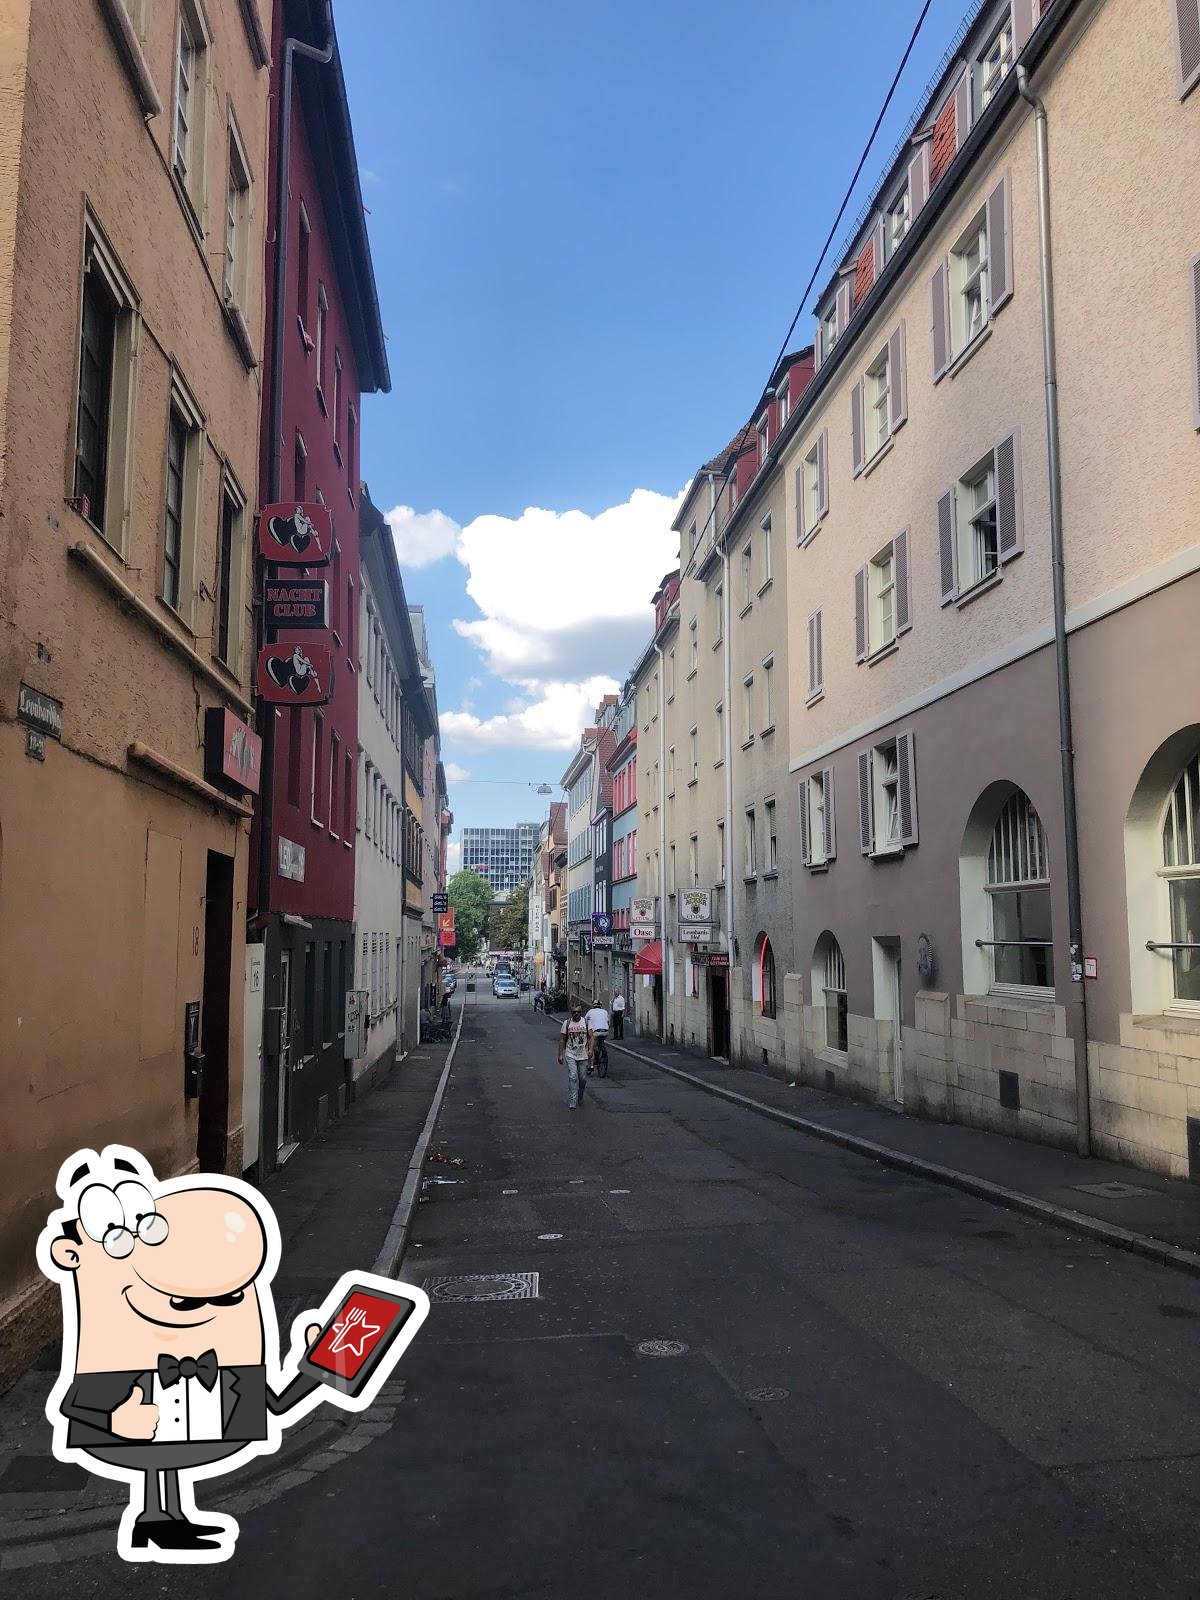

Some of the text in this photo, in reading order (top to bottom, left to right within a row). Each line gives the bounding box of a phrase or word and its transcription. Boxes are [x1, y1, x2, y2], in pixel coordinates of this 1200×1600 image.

[266, 588, 322, 602] NACHT
[273, 604, 317, 617] CLUB
[634, 928, 653, 936] Oase
[192, 926, 200, 957] 18
